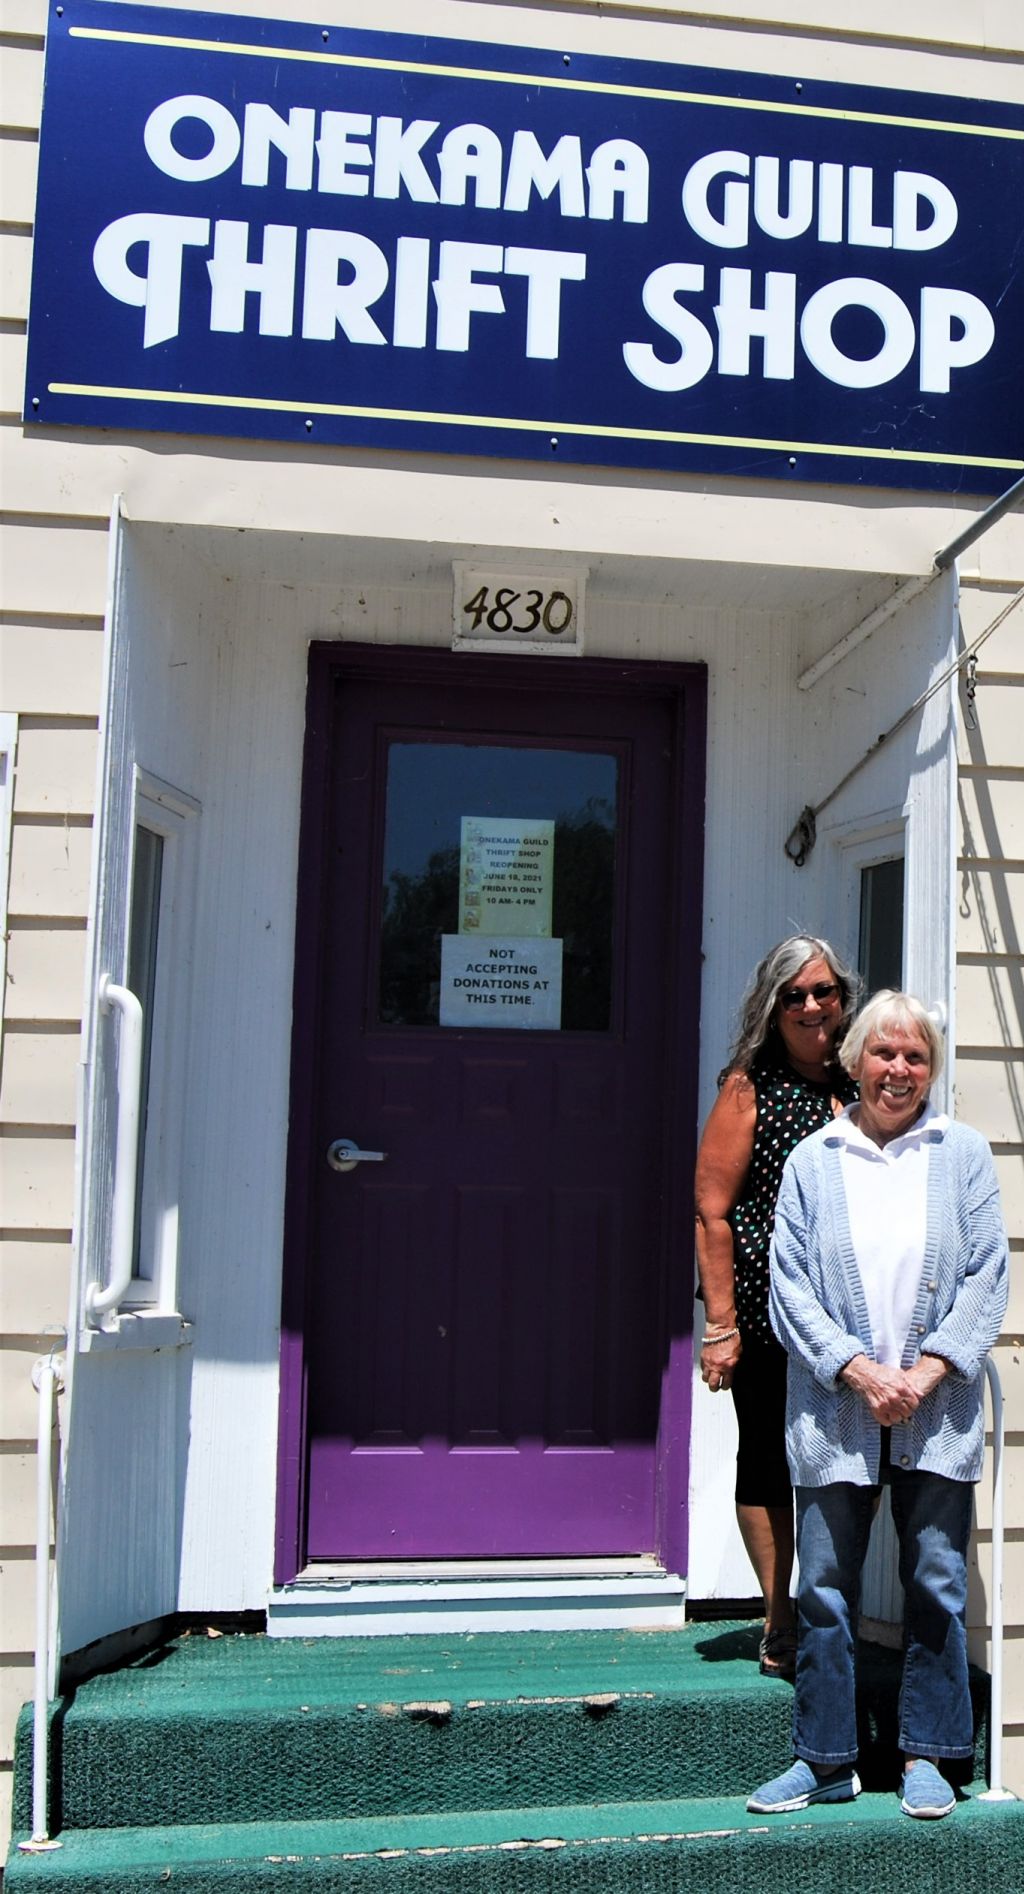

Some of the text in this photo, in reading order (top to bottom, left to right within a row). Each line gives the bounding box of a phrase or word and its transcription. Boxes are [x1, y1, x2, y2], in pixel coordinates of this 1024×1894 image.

[143, 94, 959, 252] ONEKAMA GUILD
[92, 212, 996, 395] THRIFT SHOP
[463, 586, 573, 634] 4830
[479, 836, 549, 846] ONEKAMA GUILD
[489, 861, 539, 869] REOPENING
[483, 873, 506, 881] JUNE
[519, 886, 543, 894] ONLY
[489, 949, 516, 959] NOT
[465, 963, 538, 975] ACCEPTING
[453, 978, 550, 990] DONATIONS AT
[466, 993, 536, 1005] THIS TIME.
